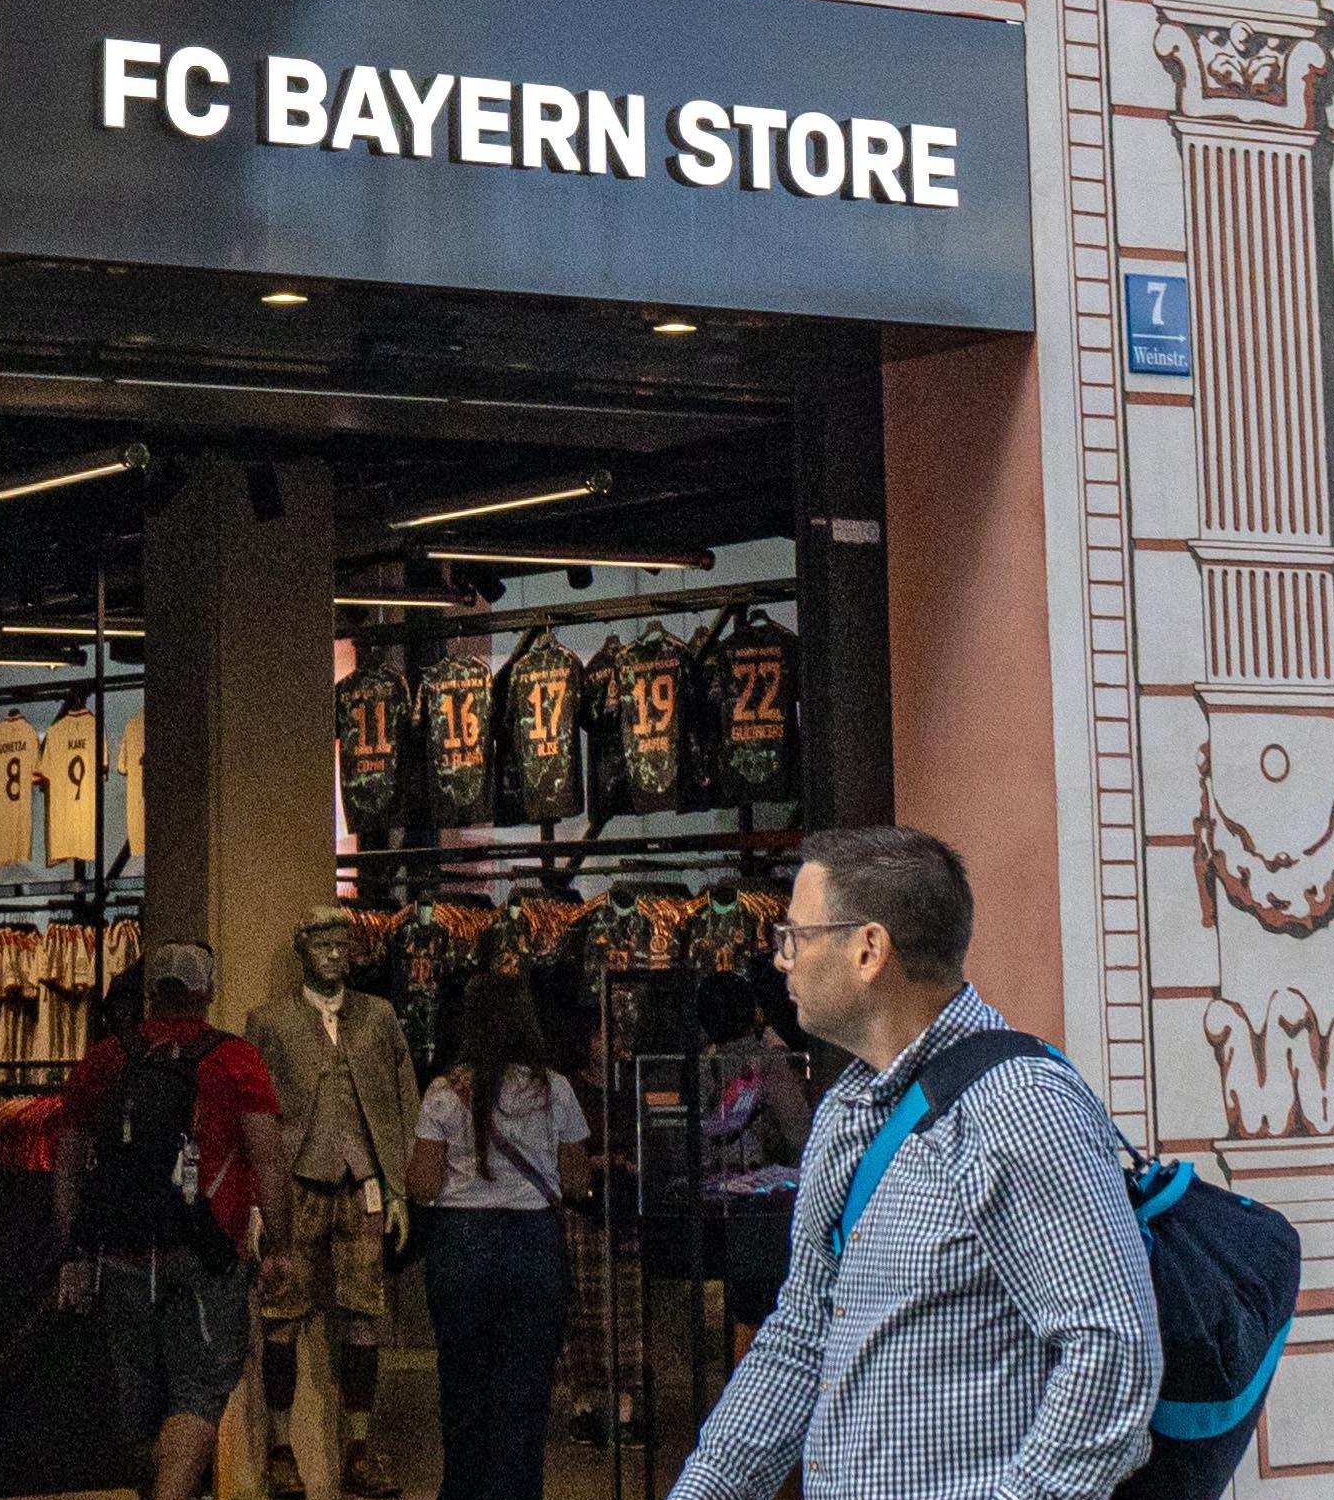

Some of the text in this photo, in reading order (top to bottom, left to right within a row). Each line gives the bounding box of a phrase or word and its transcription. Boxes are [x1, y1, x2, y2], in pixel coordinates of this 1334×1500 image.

[102, 37, 961, 208] FC BAYERN STORE
[1146, 281, 1167, 326] 7
[1132, 345, 1189, 367] Weinstr.
[528, 680, 567, 740] 17
[632, 675, 675, 735] 19
[731, 661, 785, 722] 22
[352, 701, 393, 756] 11
[440, 693, 479, 749] 16
[5, 757, 21, 802] 8
[67, 755, 86, 801] 9
